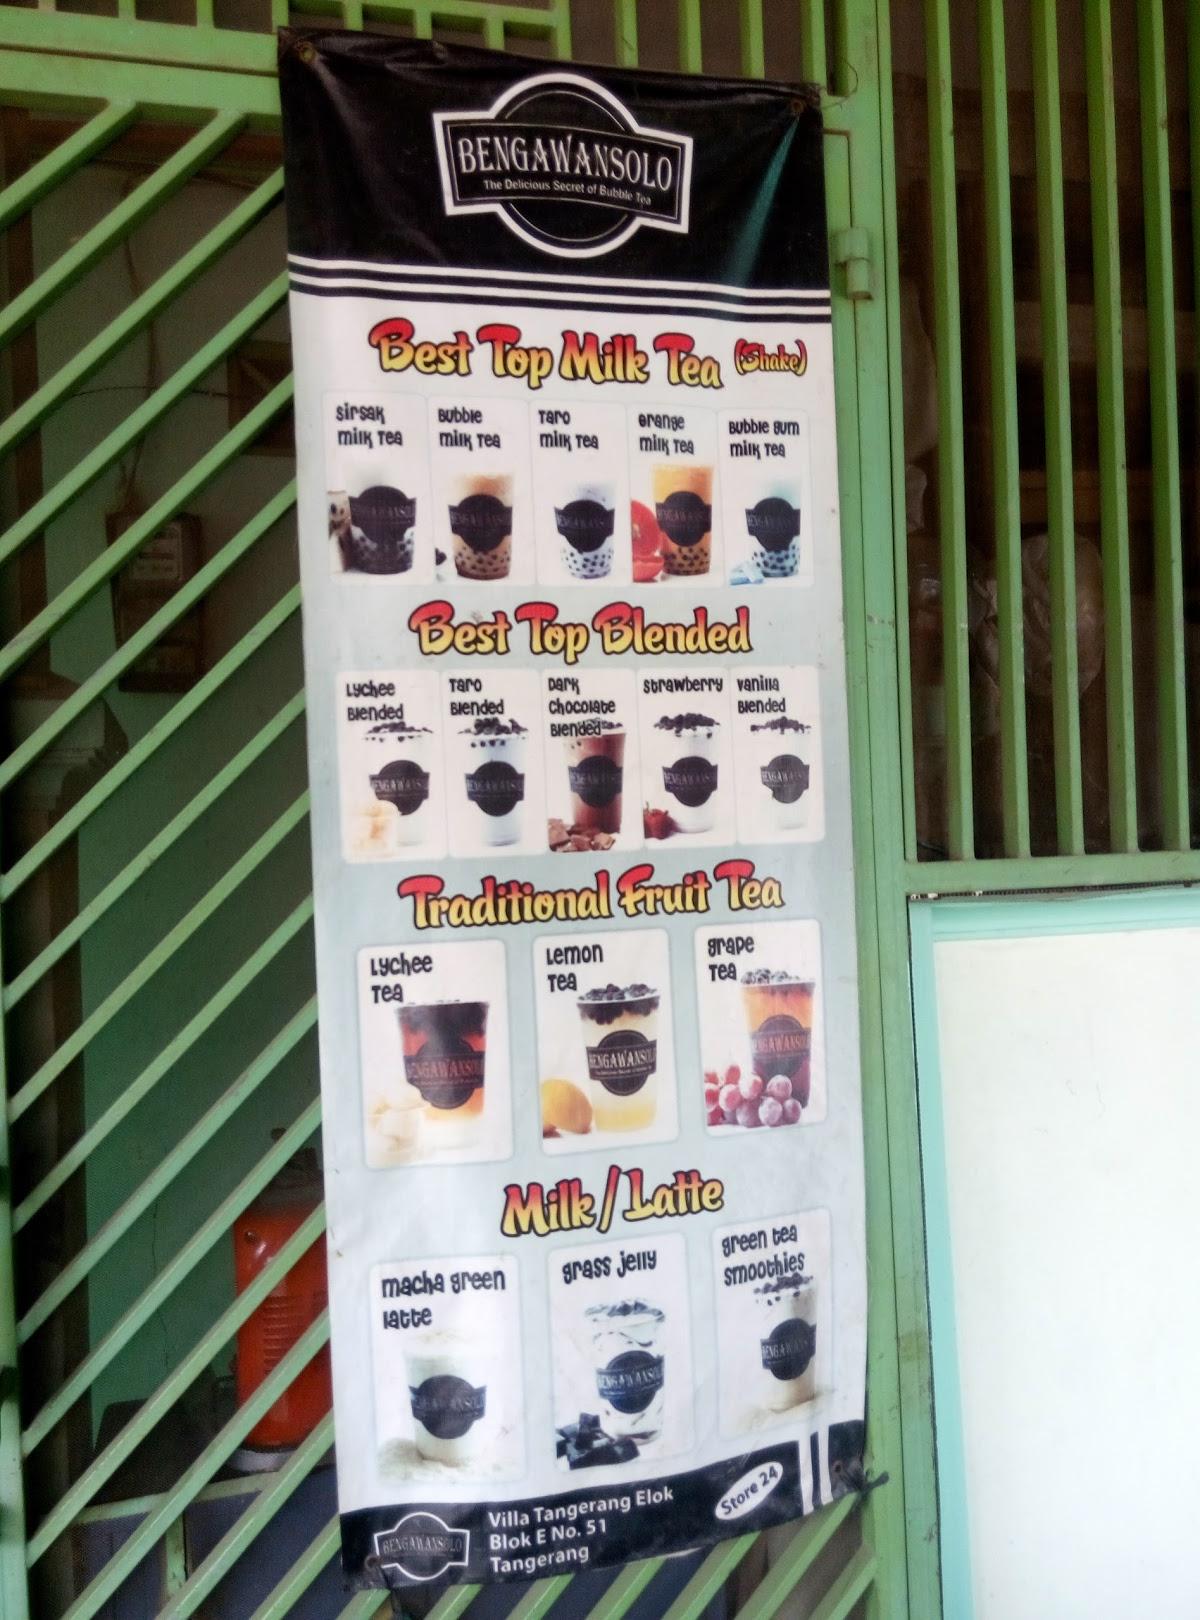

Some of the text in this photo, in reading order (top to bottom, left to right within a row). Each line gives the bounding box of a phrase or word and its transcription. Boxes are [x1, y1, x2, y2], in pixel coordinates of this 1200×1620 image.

[458, 133, 672, 191] BENGAWANSOLO
[484, 178, 651, 205] The Delicious Secret of Bubble Tea
[368, 317, 808, 389] Best Top Milk Tea (Shake)
[438, 406, 483, 424] Bubble
[729, 419, 769, 435] Bubble
[407, 600, 754, 664] Best Top Blended
[548, 677, 580, 695] Dark
[347, 704, 404, 721] Blended
[450, 699, 504, 715] Blended
[737, 698, 786, 714] Blended
[550, 722, 601, 737] Blended
[397, 859, 784, 930] Traditional Fruit Tea
[722, 1224, 798, 1257] green tea
[562, 1250, 657, 1284] grass jelly
[724, 1252, 805, 1286] smoothies
[382, 1270, 506, 1298] macha green
[383, 1307, 432, 1329] latte
[720, 1464, 779, 1516] Store 24
[489, 1486, 674, 1528] Villa Tangerang Elok
[490, 1519, 606, 1550] Blok E No. 51
[490, 1547, 589, 1573] Tangerang
